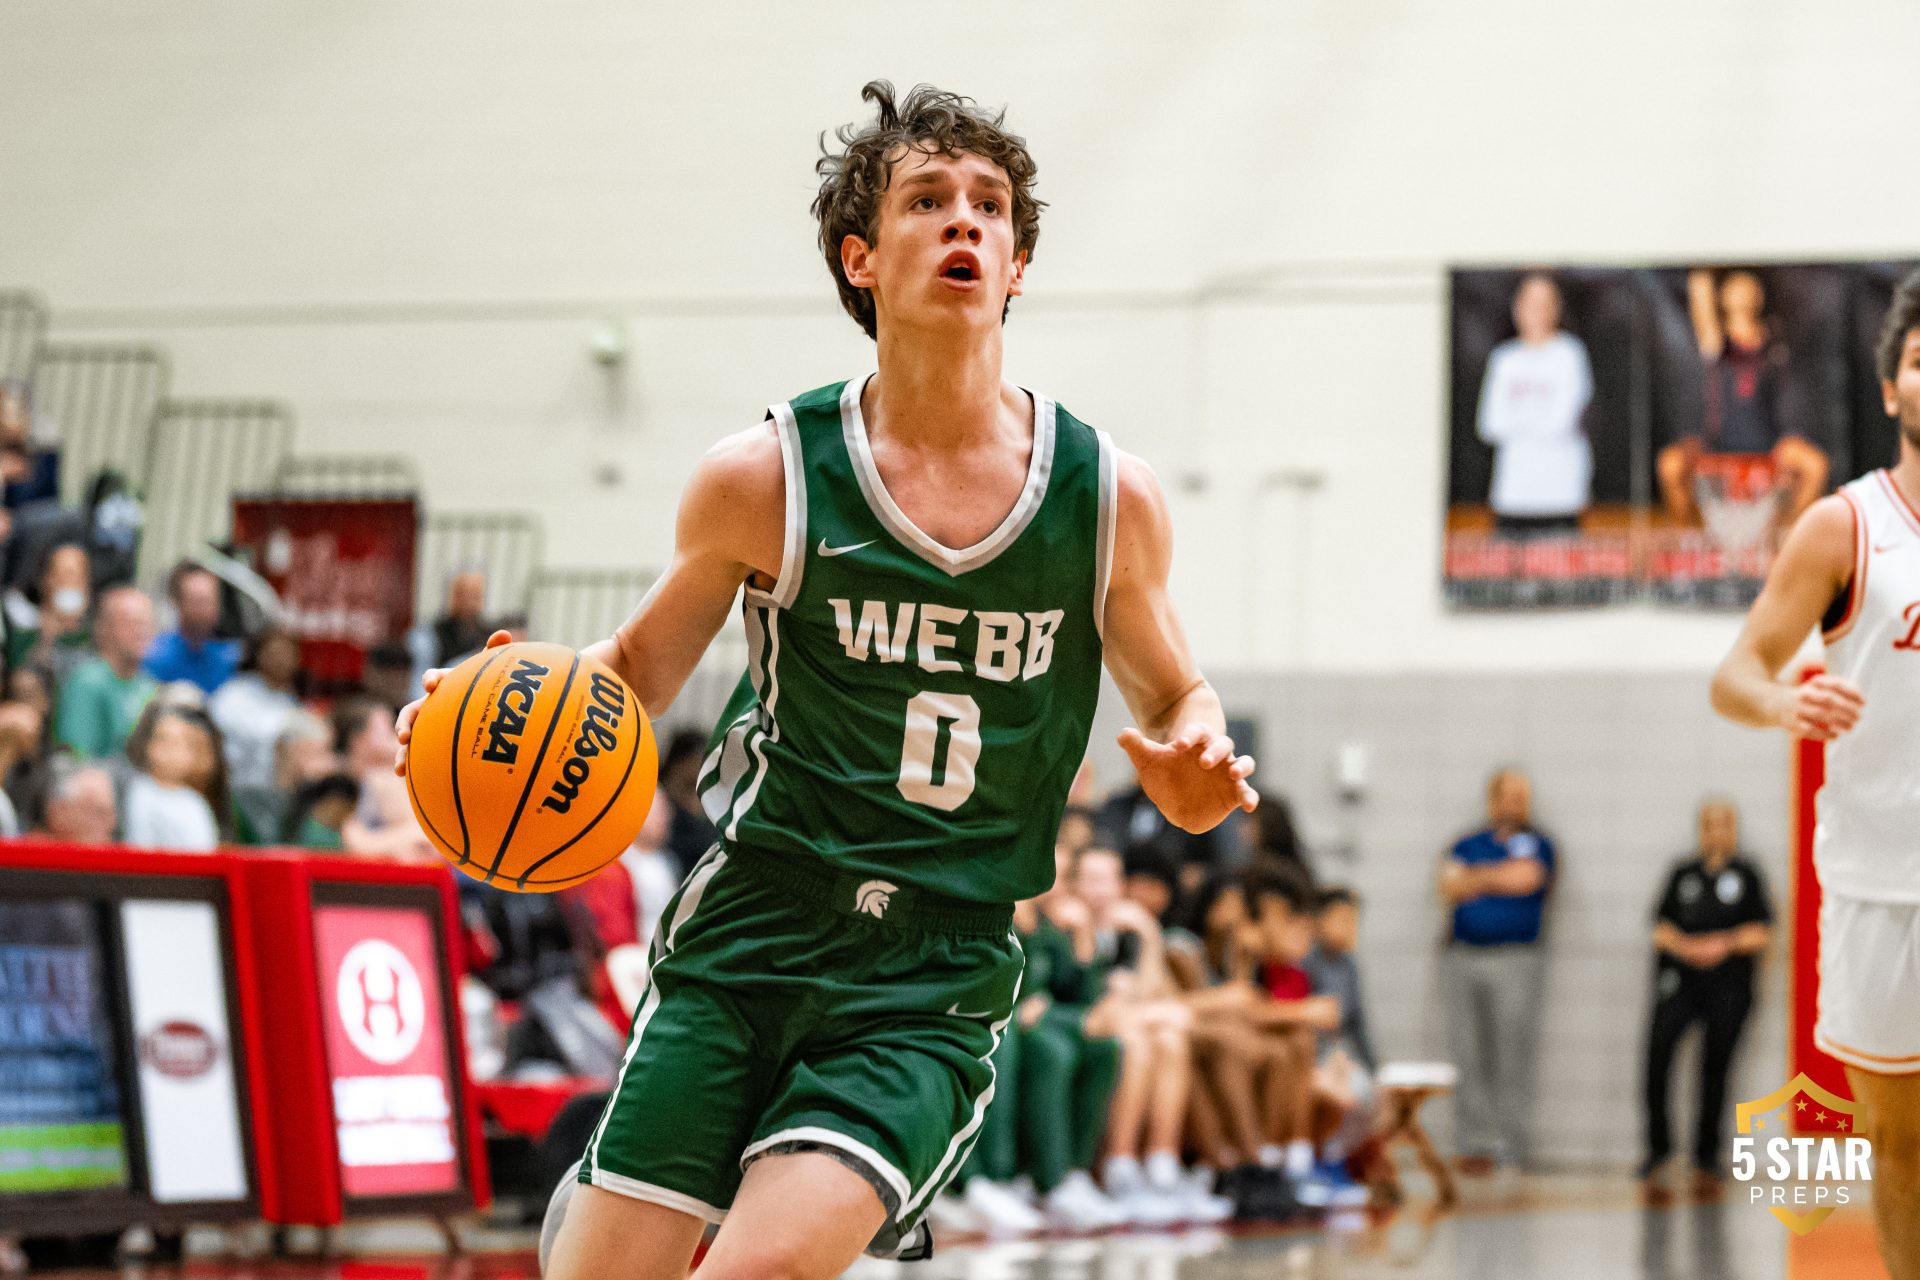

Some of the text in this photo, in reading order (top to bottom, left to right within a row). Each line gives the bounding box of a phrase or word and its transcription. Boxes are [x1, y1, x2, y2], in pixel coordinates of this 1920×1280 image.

[828, 598, 1065, 682] WEBB
[471, 727, 484, 759] BALL
[481, 659, 551, 765] NCAA
[541, 672, 625, 815] Wilson
[896, 690, 982, 812] 0
